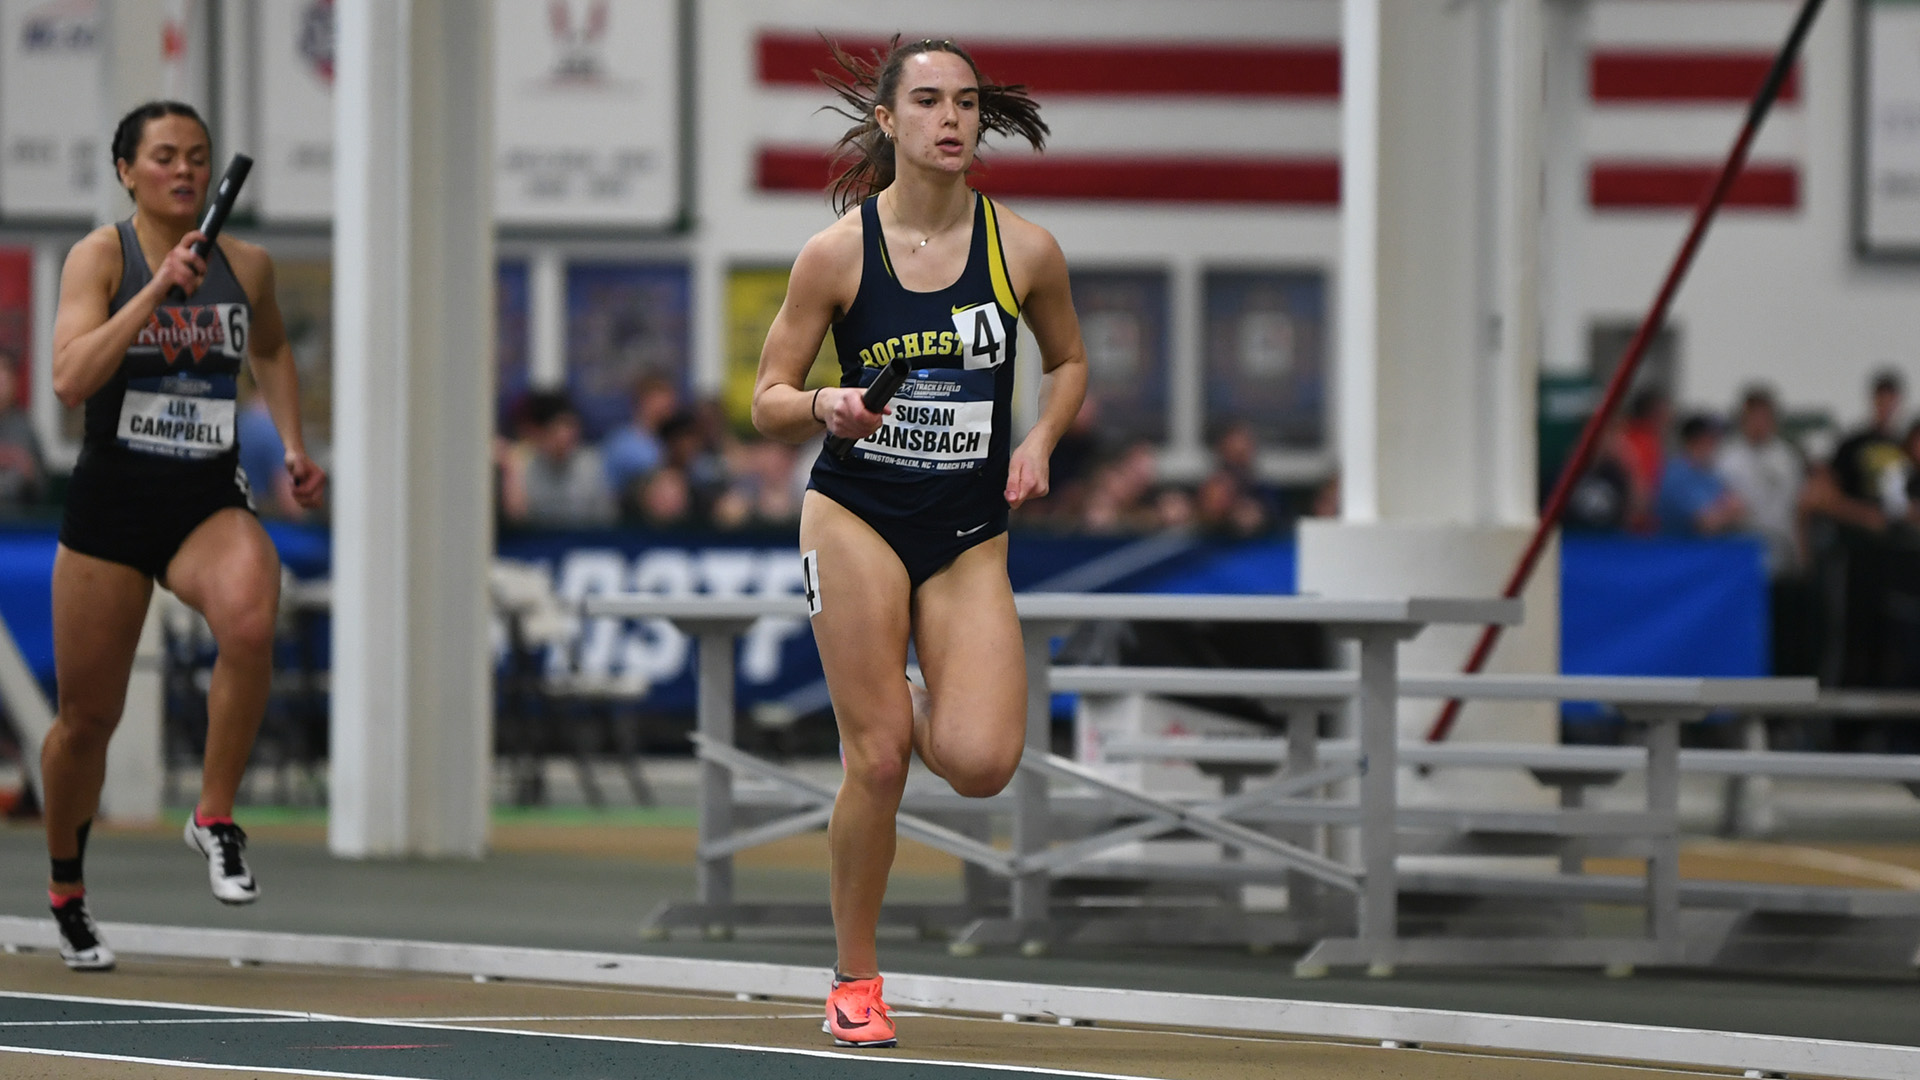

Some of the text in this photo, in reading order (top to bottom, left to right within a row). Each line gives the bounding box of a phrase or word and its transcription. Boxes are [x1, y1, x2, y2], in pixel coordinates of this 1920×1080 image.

[228, 304, 245, 353] 6
[971, 308, 1001, 364] 4
[915, 383, 937, 391] TRACK
[942, 384, 962, 392] FIELD
[167, 400, 197, 417] LILY
[895, 404, 955, 426] SUSAN
[130, 415, 222, 444] CAMPBELL
[936, 462, 960, 470] MARCH
